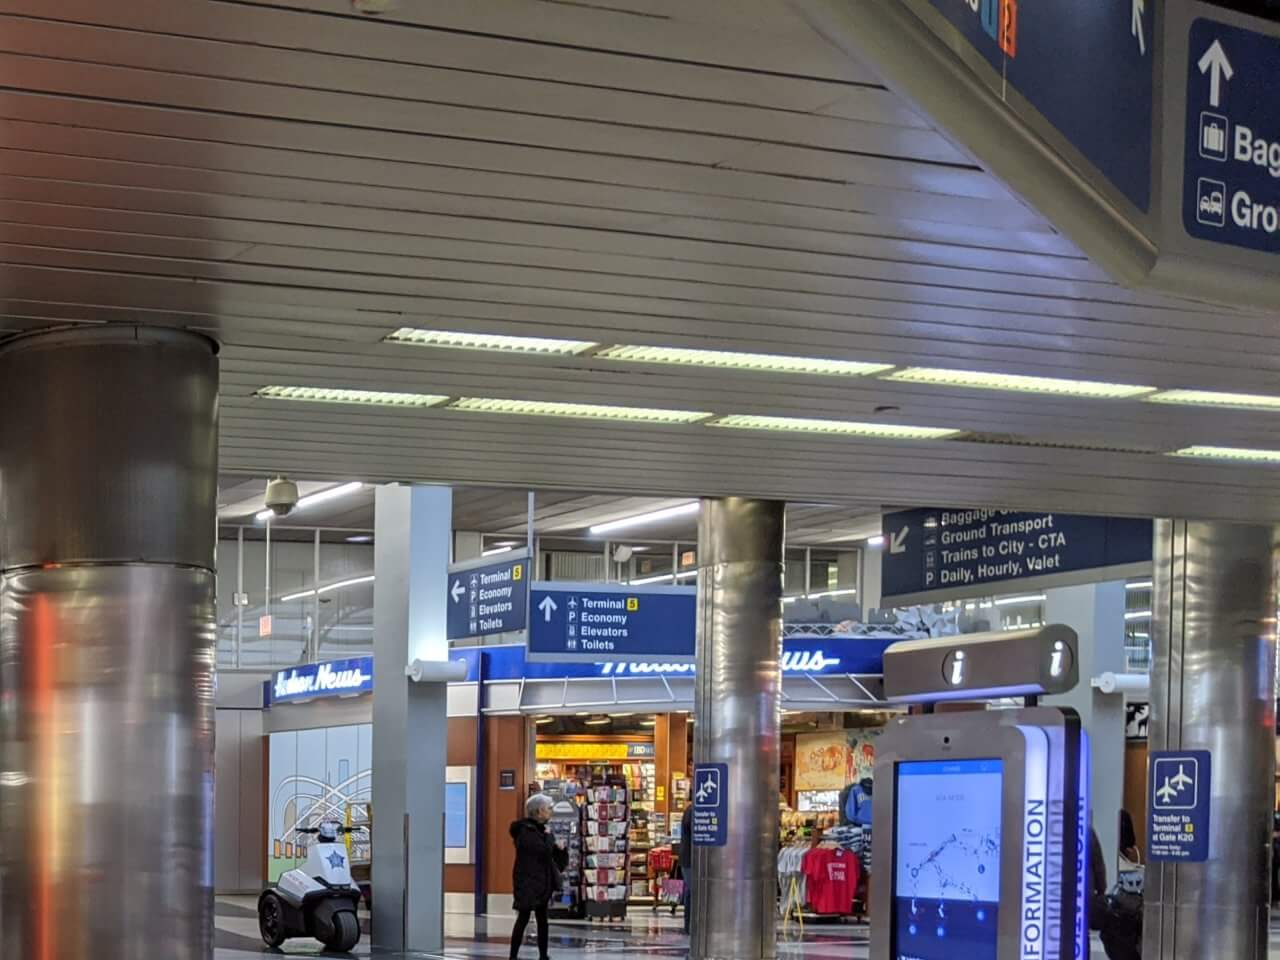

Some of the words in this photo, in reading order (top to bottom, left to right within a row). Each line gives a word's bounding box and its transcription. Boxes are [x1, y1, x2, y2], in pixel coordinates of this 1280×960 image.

[1231, 190, 1278, 233] Gro
[941, 526, 986, 544] Ground
[990, 514, 1053, 538] Transport
[942, 547, 978, 564] Trains
[982, 544, 995, 557] to
[999, 540, 1025, 556] City
[1038, 532, 1066, 549] CTA
[941, 569, 974, 584] Daily,
[978, 560, 1023, 578] Hourly,
[1026, 554, 1060, 571] Valet
[480, 569, 511, 584] Terminal
[479, 587, 512, 600] Economy
[479, 602, 512, 616] Elevators
[581, 598, 625, 609] Terminal
[479, 618, 503, 631] Toilets
[581, 612, 627, 624] Economy
[581, 626, 628, 637] Elevators
[581, 640, 615, 650] Toilets
[313, 663, 372, 691] News
[1182, 815, 1191, 823] to
[1153, 824, 1182, 833] Terminal
